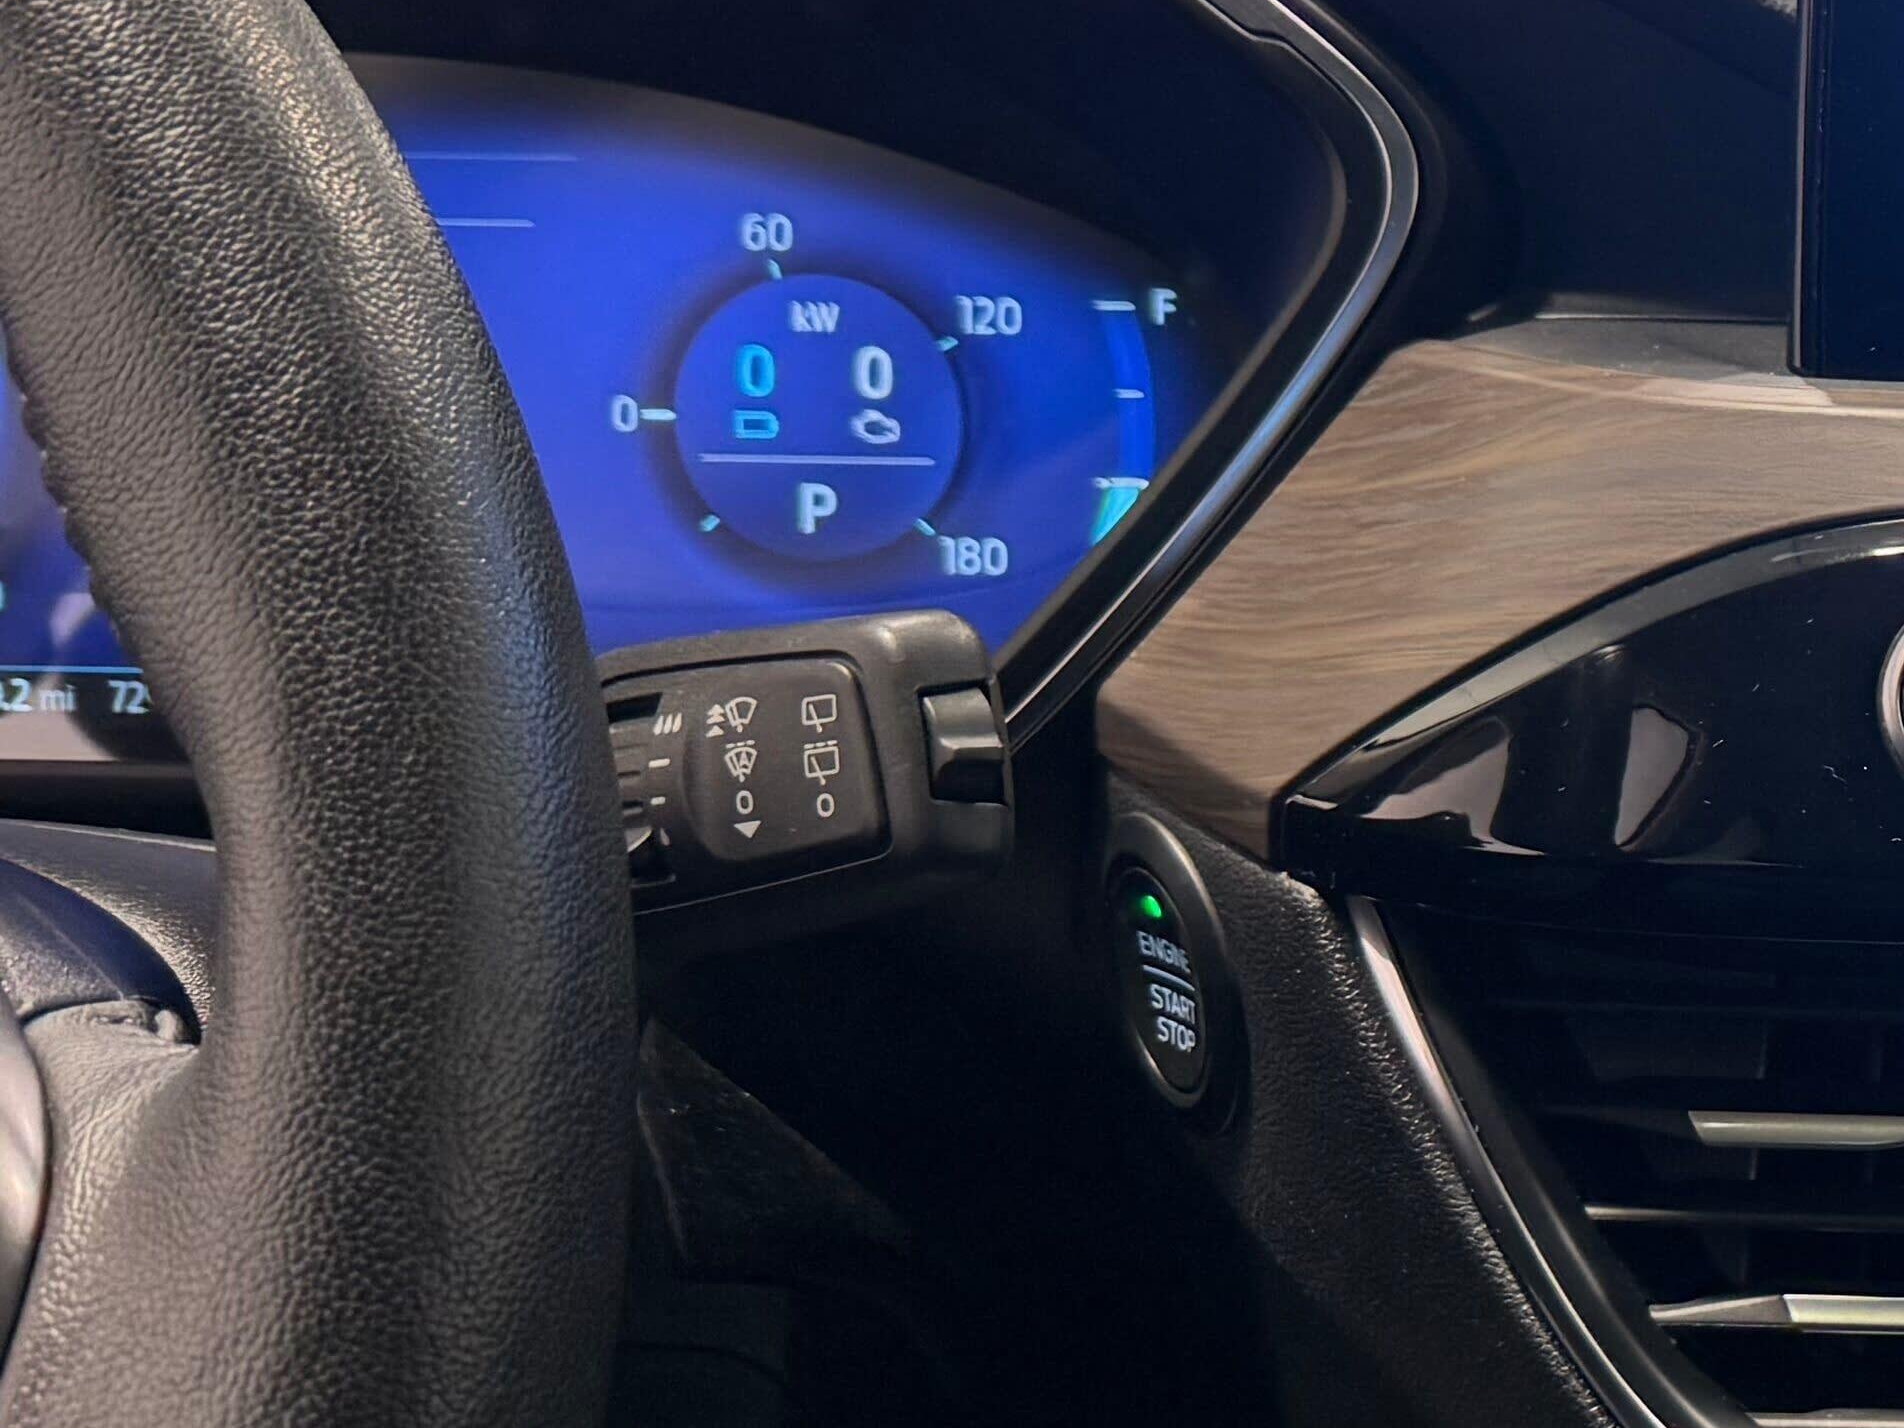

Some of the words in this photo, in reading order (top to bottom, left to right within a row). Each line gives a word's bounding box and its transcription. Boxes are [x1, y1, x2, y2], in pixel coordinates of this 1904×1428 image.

[741, 212, 794, 253] 60
[789, 299, 841, 335] kW
[957, 295, 1023, 336] 120
[1150, 288, 1178, 326] F
[738, 344, 776, 398] 0
[855, 345, 893, 399] 0
[610, 394, 639, 433] 0
[799, 483, 838, 534] P
[938, 536, 1009, 576] 180
[38, 683, 77, 712] mi
[1136, 930, 1191, 973] ENGINE
[1150, 983, 1196, 1024] START
[1156, 1016, 1196, 1052] STOP
